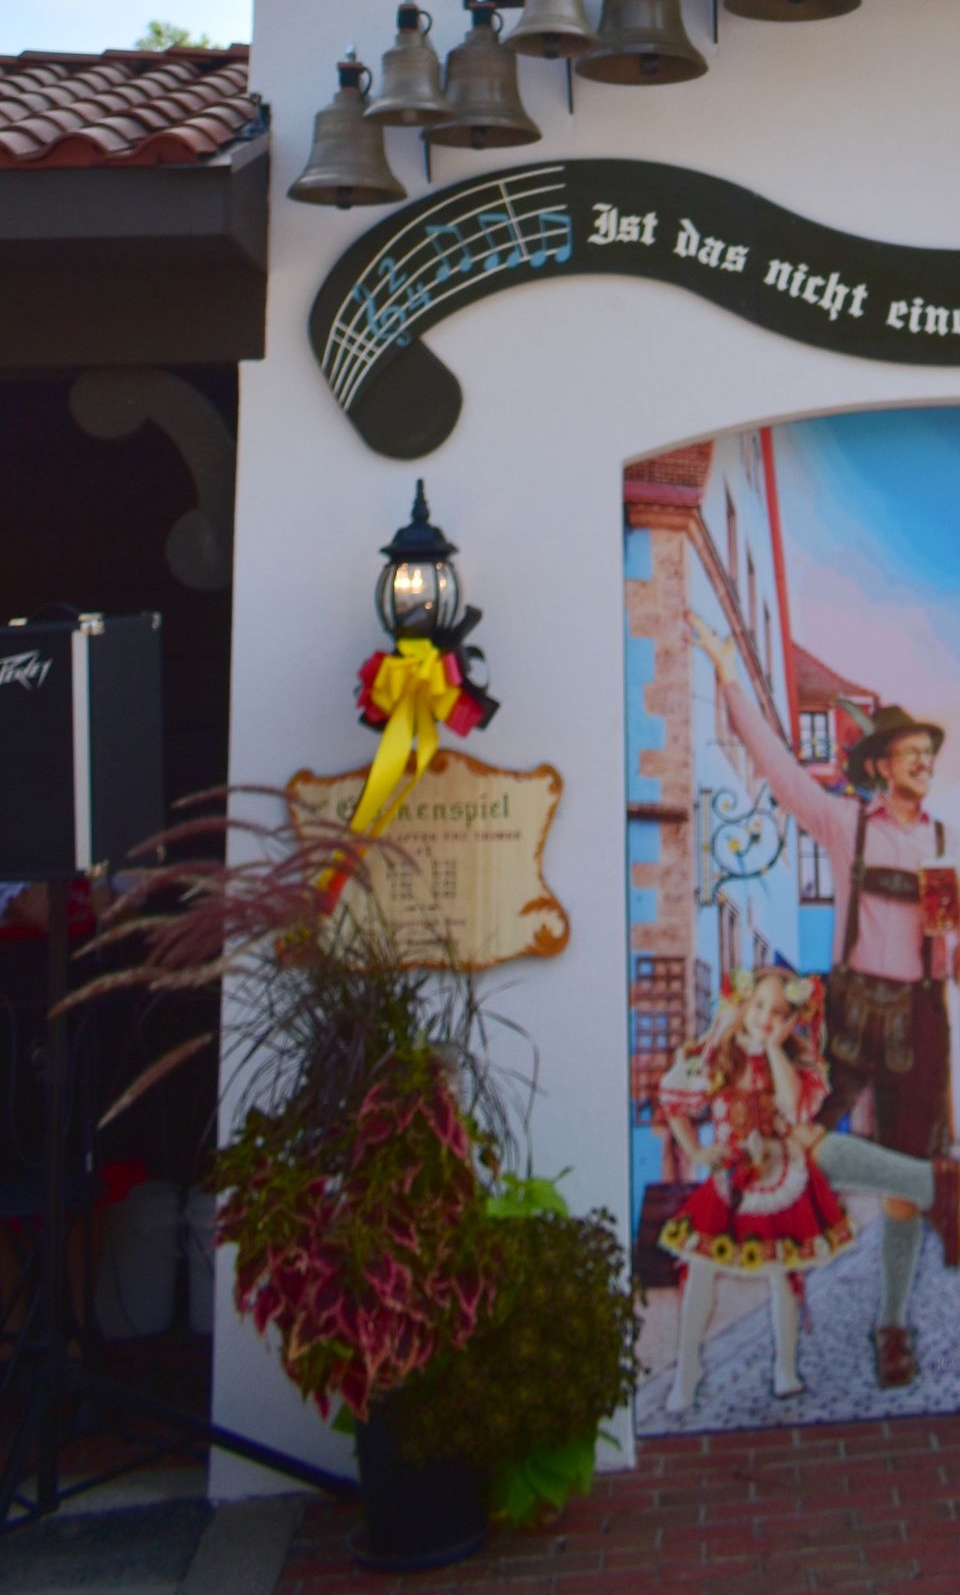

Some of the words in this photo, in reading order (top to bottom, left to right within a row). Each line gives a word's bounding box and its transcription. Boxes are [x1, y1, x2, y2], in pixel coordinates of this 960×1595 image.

[588, 203, 659, 246] Ist
[673, 218, 750, 273] das
[764, 258, 870, 322] nicht
